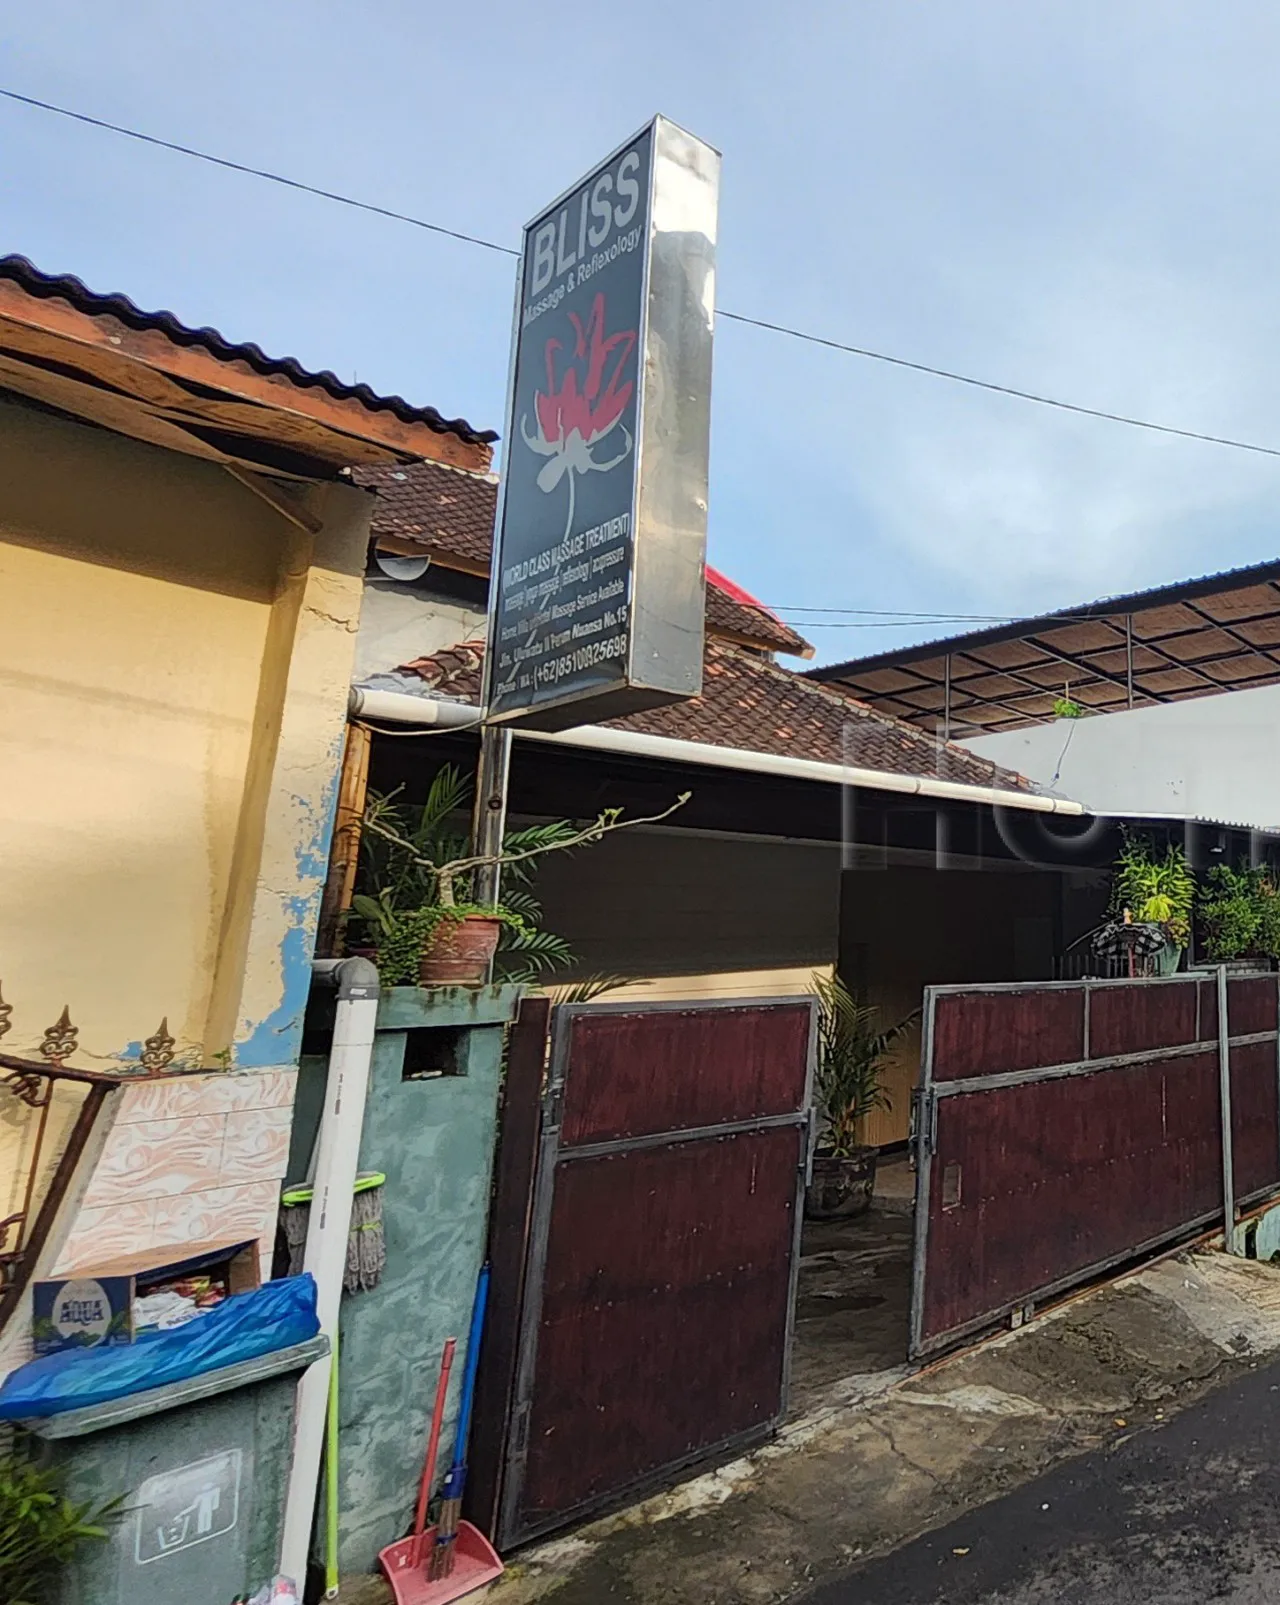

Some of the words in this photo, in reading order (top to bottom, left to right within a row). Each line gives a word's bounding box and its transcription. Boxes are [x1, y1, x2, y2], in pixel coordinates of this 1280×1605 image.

[532, 151, 639, 296] BLISS
[523, 285, 564, 327] Massage
[567, 272, 575, 293] &
[577, 225, 642, 285] Reflexology
[551, 534, 584, 566] MASSAGE
[577, 589, 597, 610] Service
[598, 577, 624, 602] Available
[617, 605, 627, 623] 15
